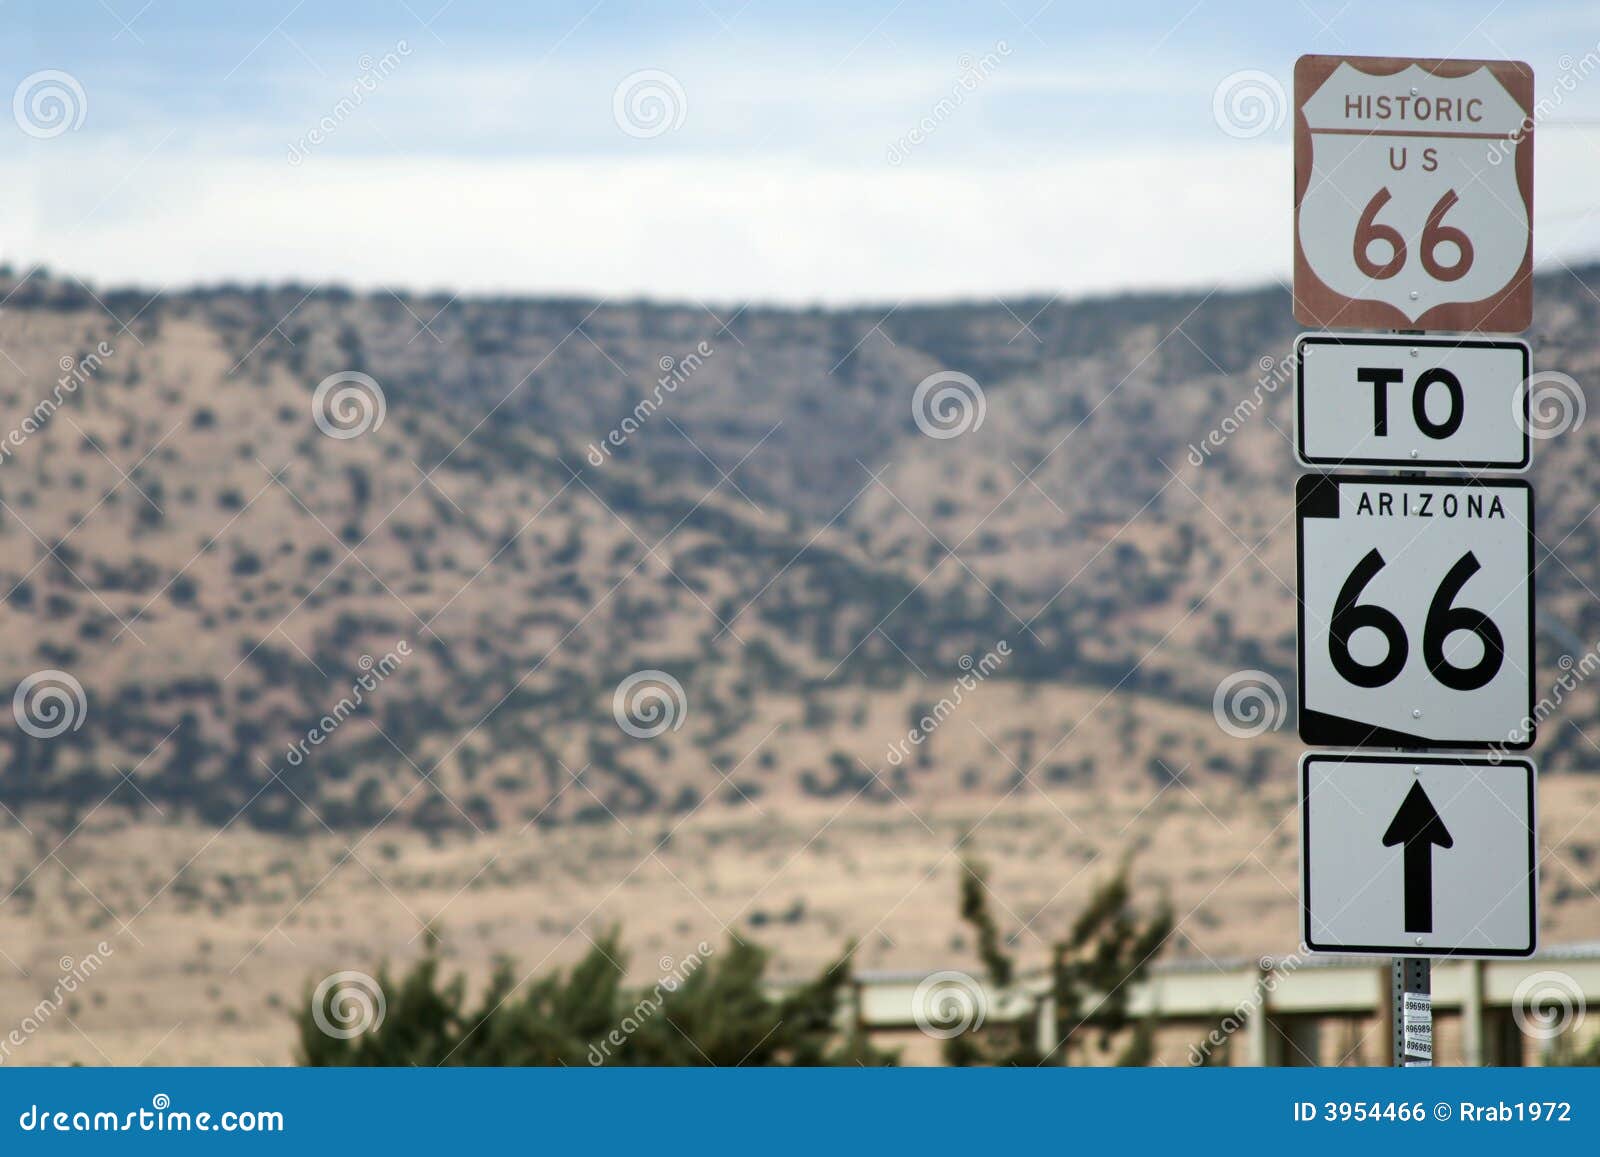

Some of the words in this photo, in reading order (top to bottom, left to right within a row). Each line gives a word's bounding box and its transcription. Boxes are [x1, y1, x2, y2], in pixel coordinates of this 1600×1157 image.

[1344, 94, 1483, 123] HISTORIC
[1352, 185, 1475, 282] 66
[1356, 366, 1465, 440] TO
[1356, 491, 1506, 520] ARIZONA
[1328, 546, 1505, 692] 66
